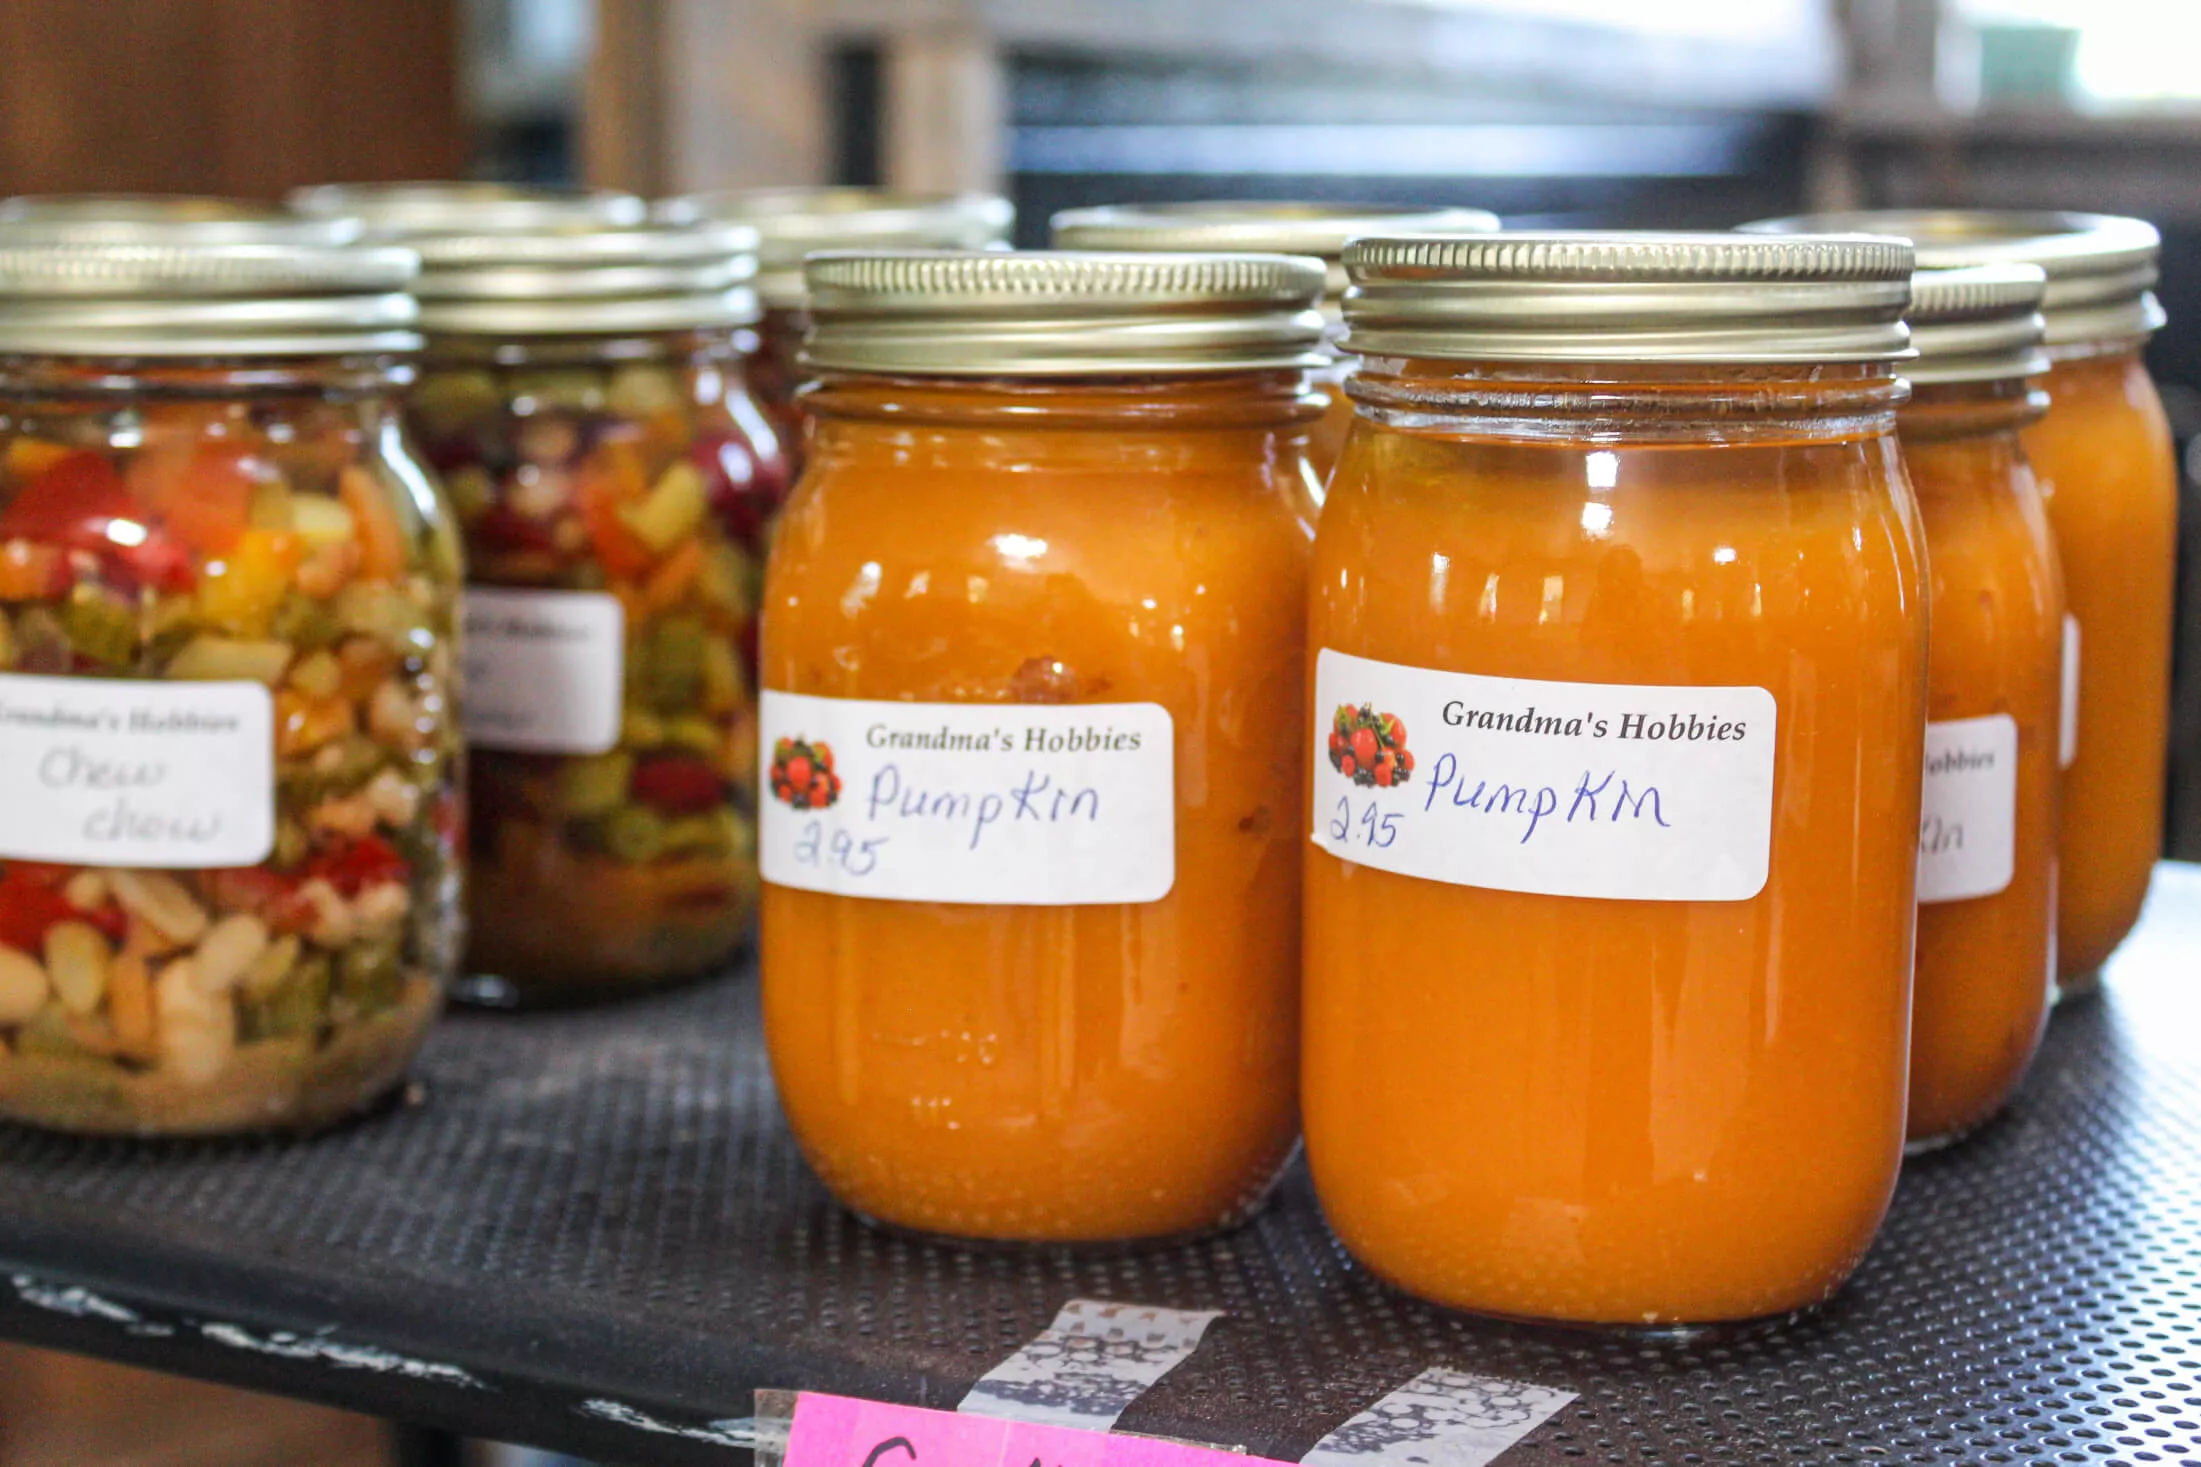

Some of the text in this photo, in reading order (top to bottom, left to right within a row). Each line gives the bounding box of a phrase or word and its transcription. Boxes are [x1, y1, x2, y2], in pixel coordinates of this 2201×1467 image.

[0, 699, 119, 733] randma's
[1442, 700, 1747, 742] Grandma's Hobbies
[866, 723, 1142, 753] Grandma's Hobbies
[1925, 747, 1995, 775] obbies
[1330, 795, 1404, 848] 2.95
